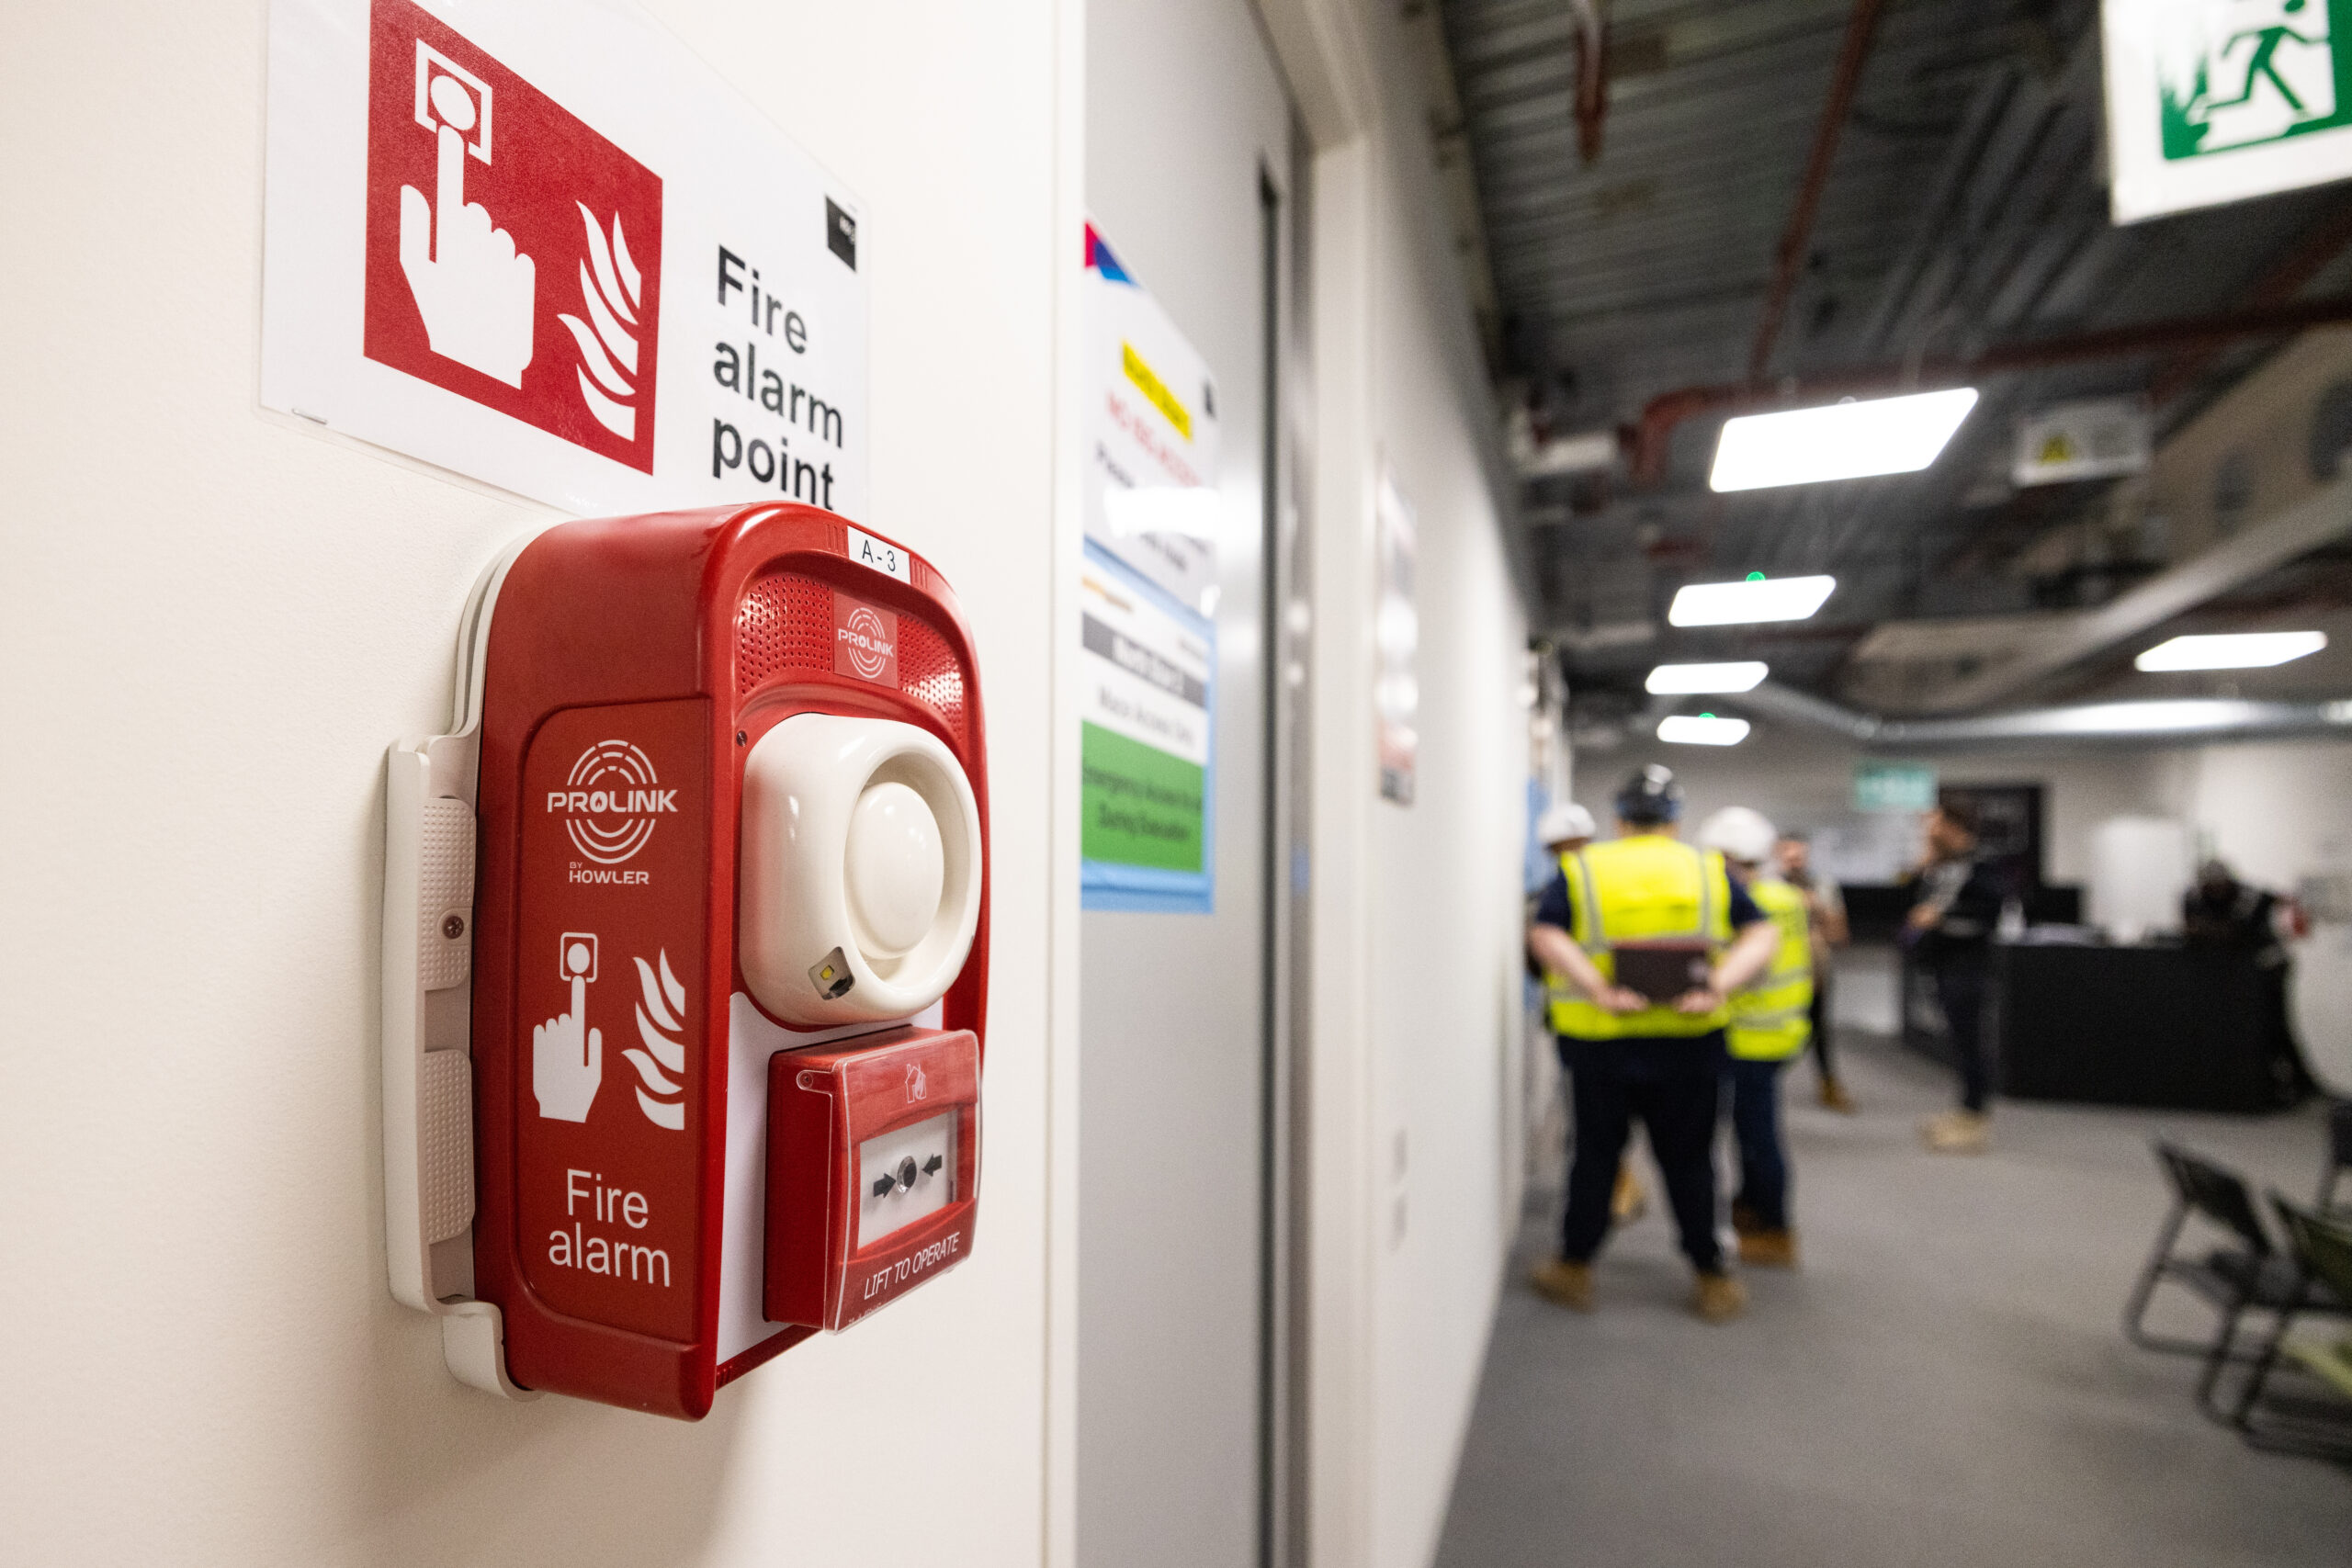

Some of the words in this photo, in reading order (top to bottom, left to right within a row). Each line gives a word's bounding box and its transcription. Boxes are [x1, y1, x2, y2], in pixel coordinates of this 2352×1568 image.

[718, 243, 807, 355] Fire
[713, 341, 842, 449] alarm
[712, 417, 834, 511] point
[837, 628, 894, 658] PROLINK
[547, 789, 678, 813] PROLINK
[569, 861, 583, 869] BY
[569, 869, 650, 886] HOWLER
[567, 1168, 649, 1229] Fire
[548, 1222, 671, 1288] alarm
[864, 1266, 893, 1301] LIFT
[894, 1257, 910, 1284] TO
[911, 1231, 961, 1274] OPERATE
